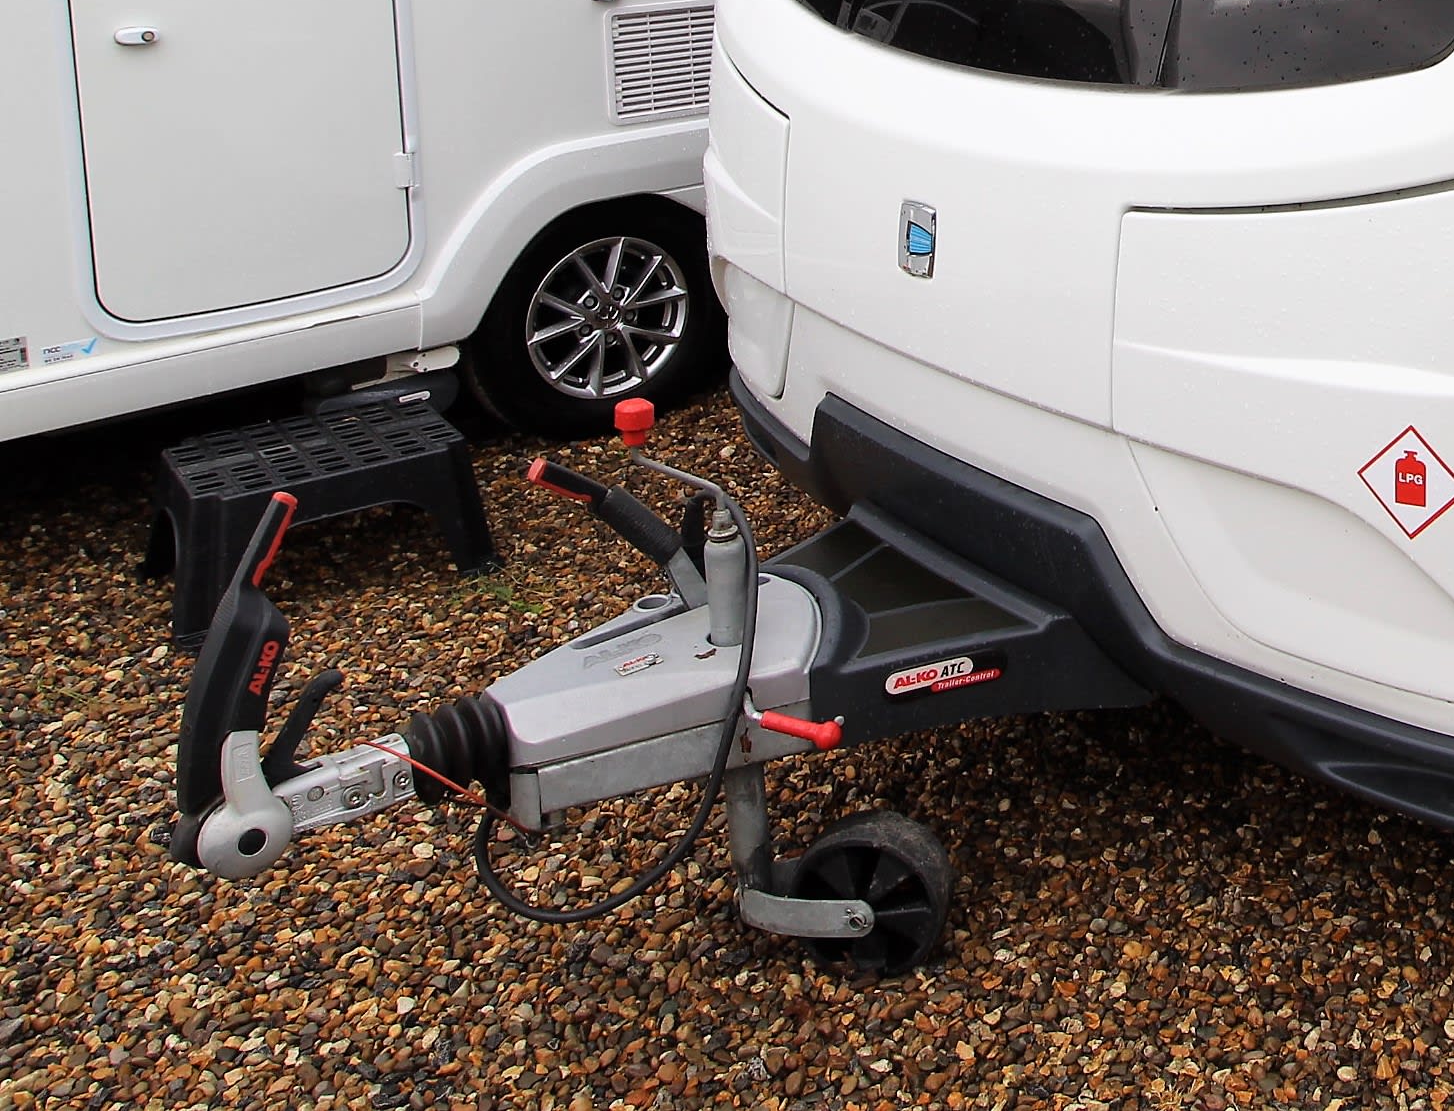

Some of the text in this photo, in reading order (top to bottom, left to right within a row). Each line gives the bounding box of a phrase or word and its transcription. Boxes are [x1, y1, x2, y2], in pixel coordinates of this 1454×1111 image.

[1398, 472, 1424, 486] LPG
[248, 640, 281, 696] AL-KO
[893, 661, 965, 690] AL-KO ATC
